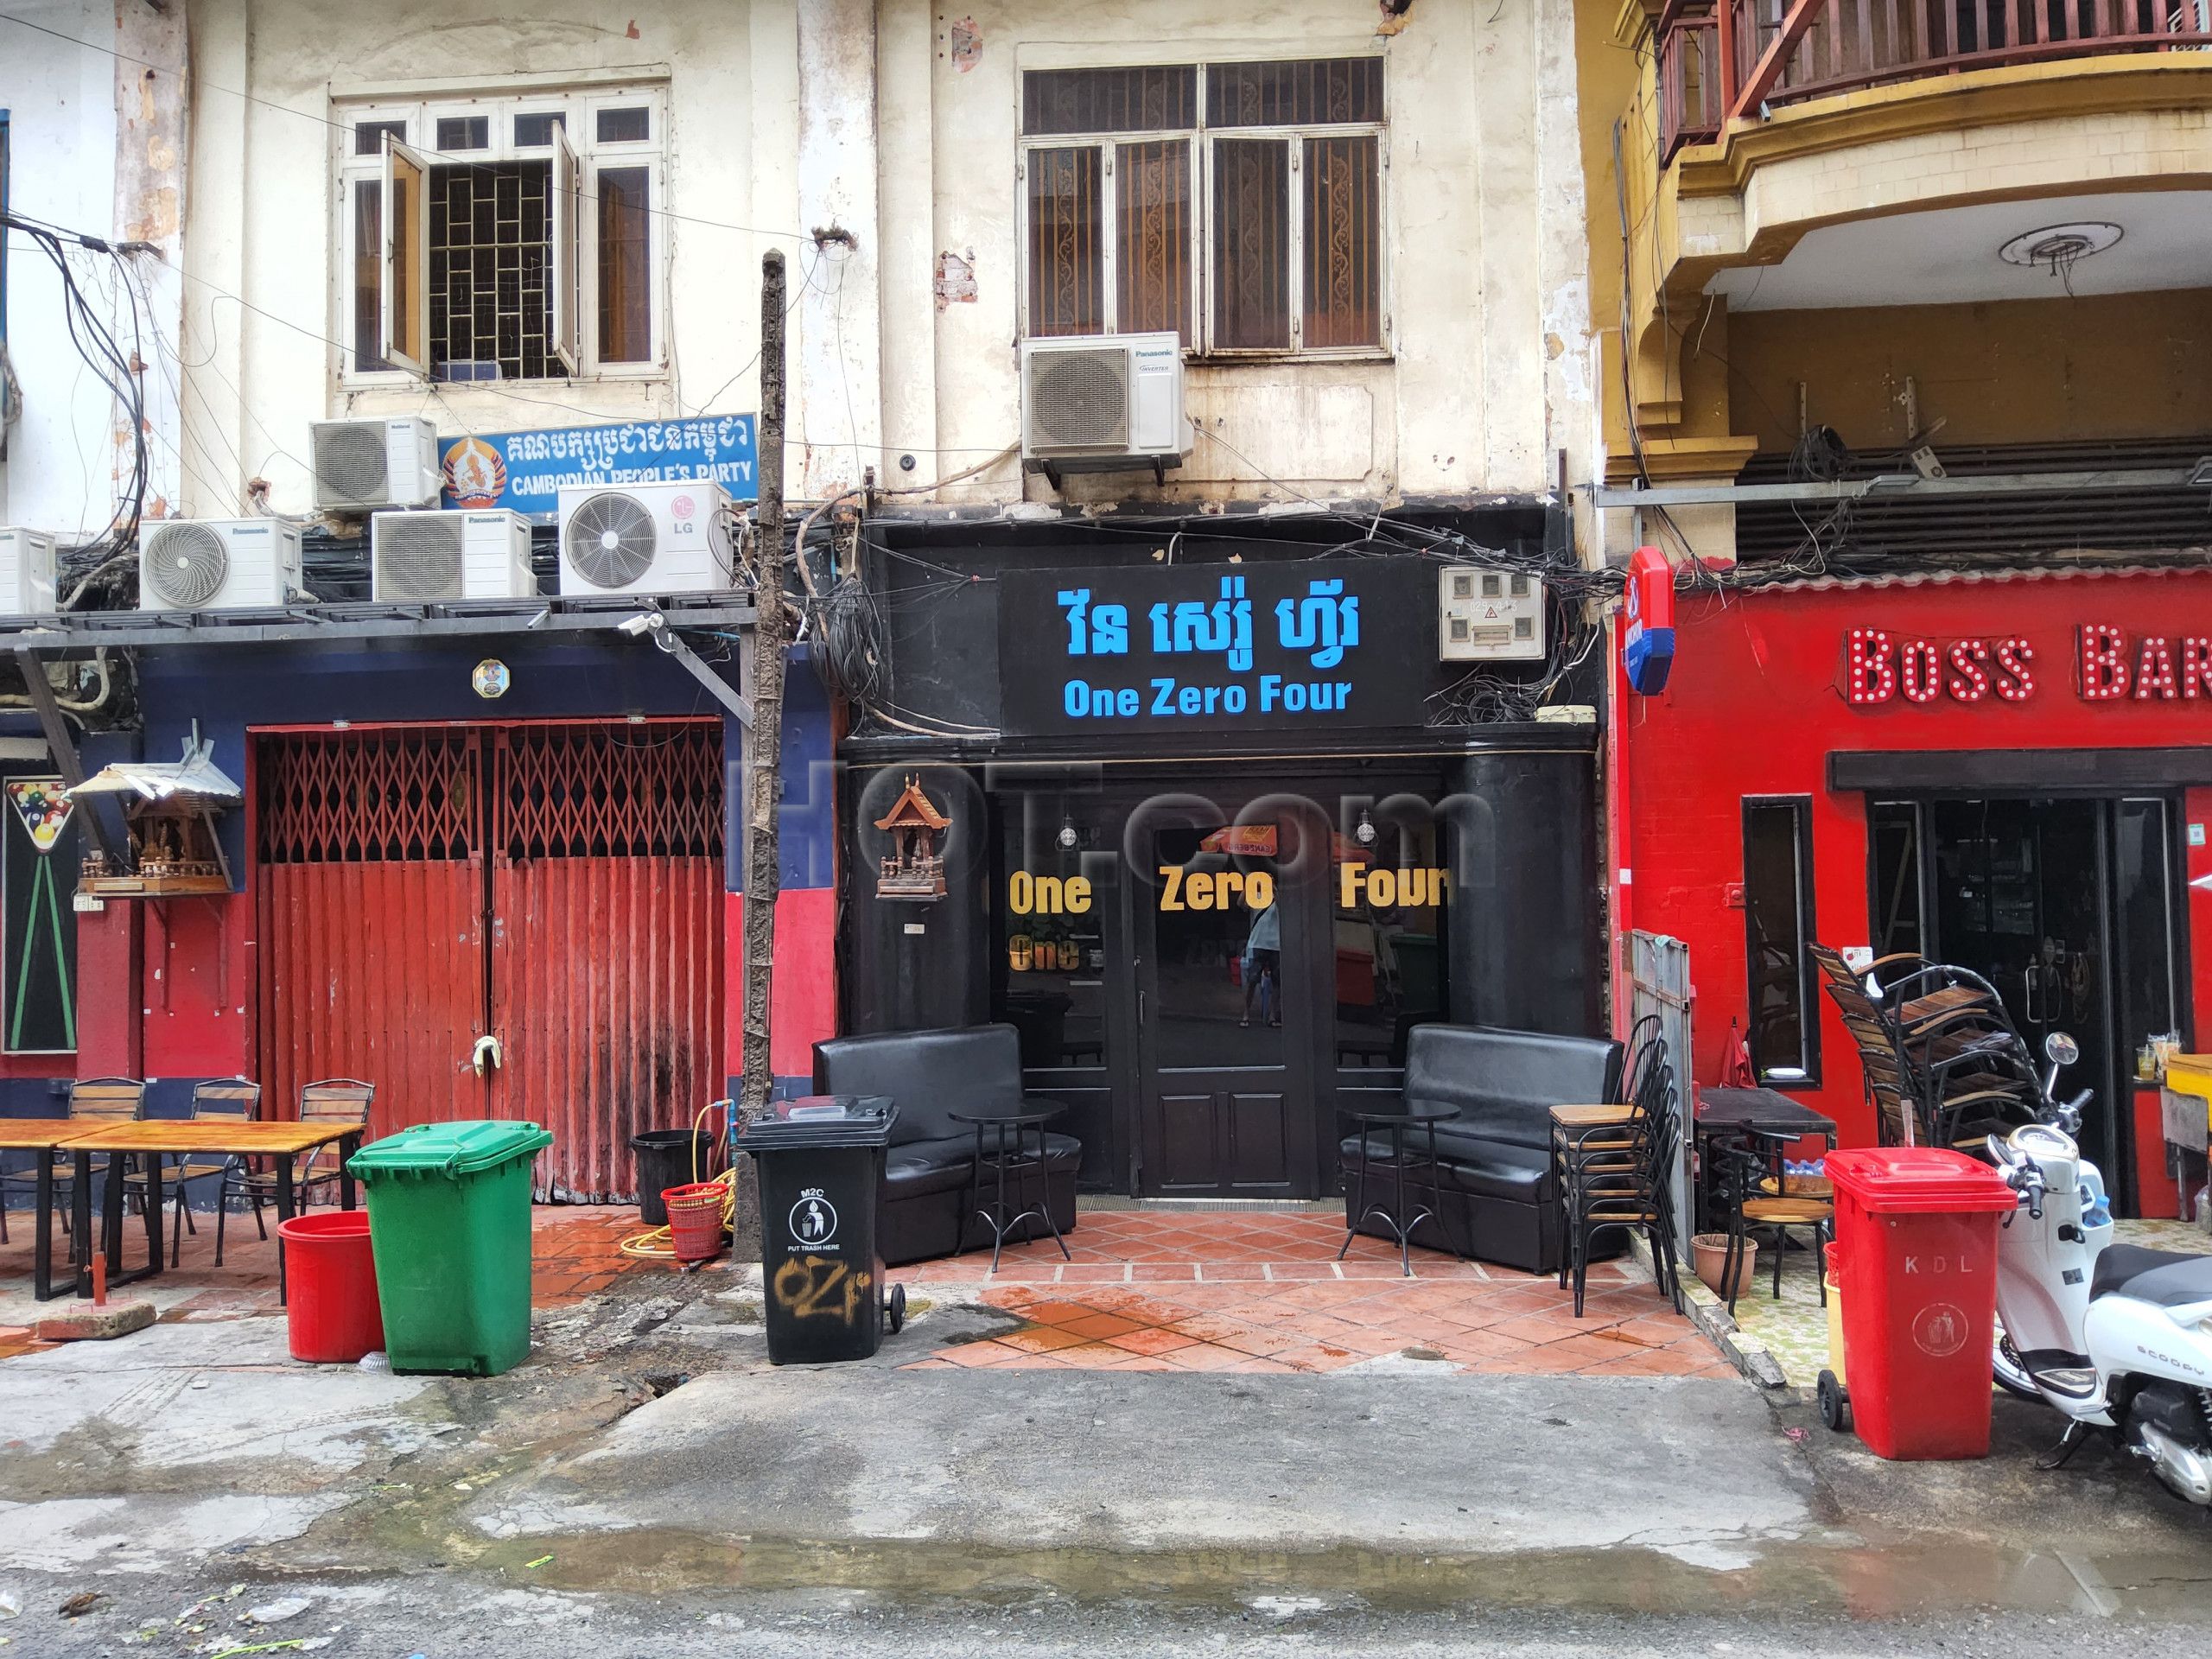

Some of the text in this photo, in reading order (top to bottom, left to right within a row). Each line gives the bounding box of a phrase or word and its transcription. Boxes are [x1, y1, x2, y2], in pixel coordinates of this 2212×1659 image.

[512, 470, 605, 495] CAMBODIAN
[611, 463, 690, 485] PEOPLE'S
[696, 461, 752, 484] PARTY
[674, 522, 693, 534] LG
[1064, 675, 1352, 717] One Zero Four
[1009, 870, 1092, 914] One
[1159, 866, 1274, 911] Zero
[800, 1187, 824, 1198] M2C
